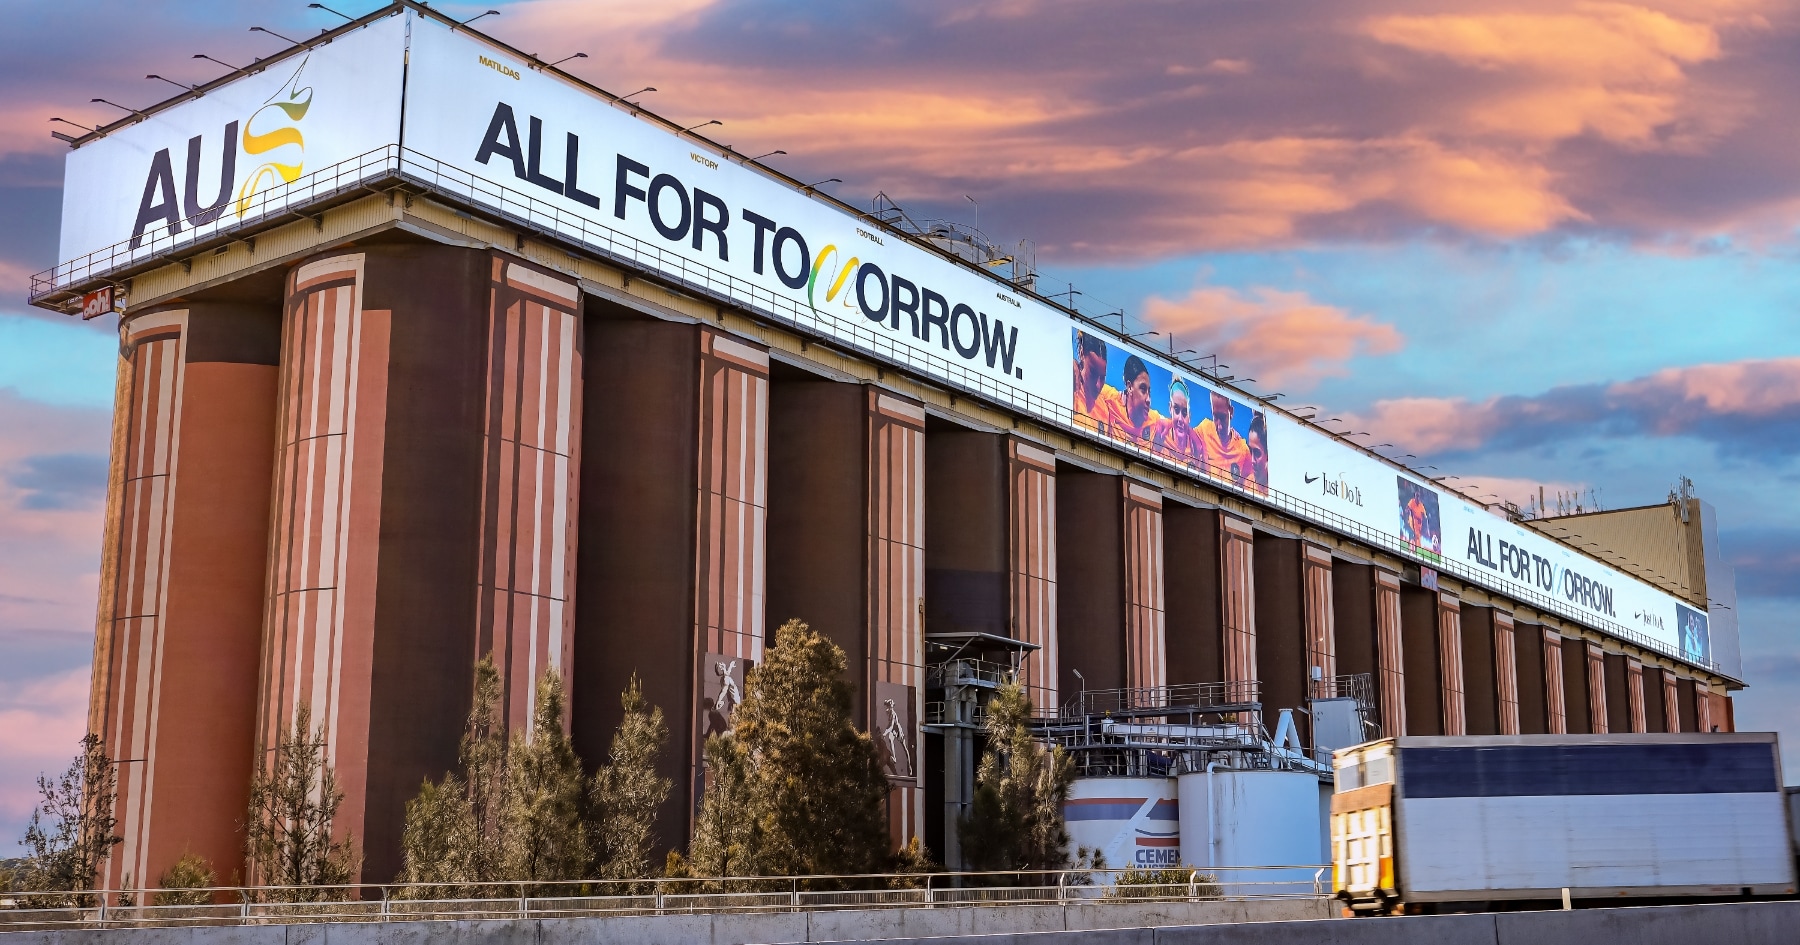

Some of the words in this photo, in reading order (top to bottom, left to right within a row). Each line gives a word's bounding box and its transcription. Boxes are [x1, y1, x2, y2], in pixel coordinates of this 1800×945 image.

[479, 55, 520, 80] MATILDAS
[128, 53, 313, 250] AUS
[690, 152, 719, 171] VICTORY
[474, 101, 600, 210] ALL
[614, 153, 729, 262] FOR
[742, 208, 1023, 380] TOMORROW.
[856, 227, 884, 247] FOOTBALL
[996, 292, 1021, 309] AUSTRALIA
[1322, 471, 1339, 497] Just
[1339, 471, 1354, 503] Do
[1467, 526, 1497, 570] ALL
[1499, 539, 1531, 584] FOR
[1135, 848, 1181, 864] CEMEN
